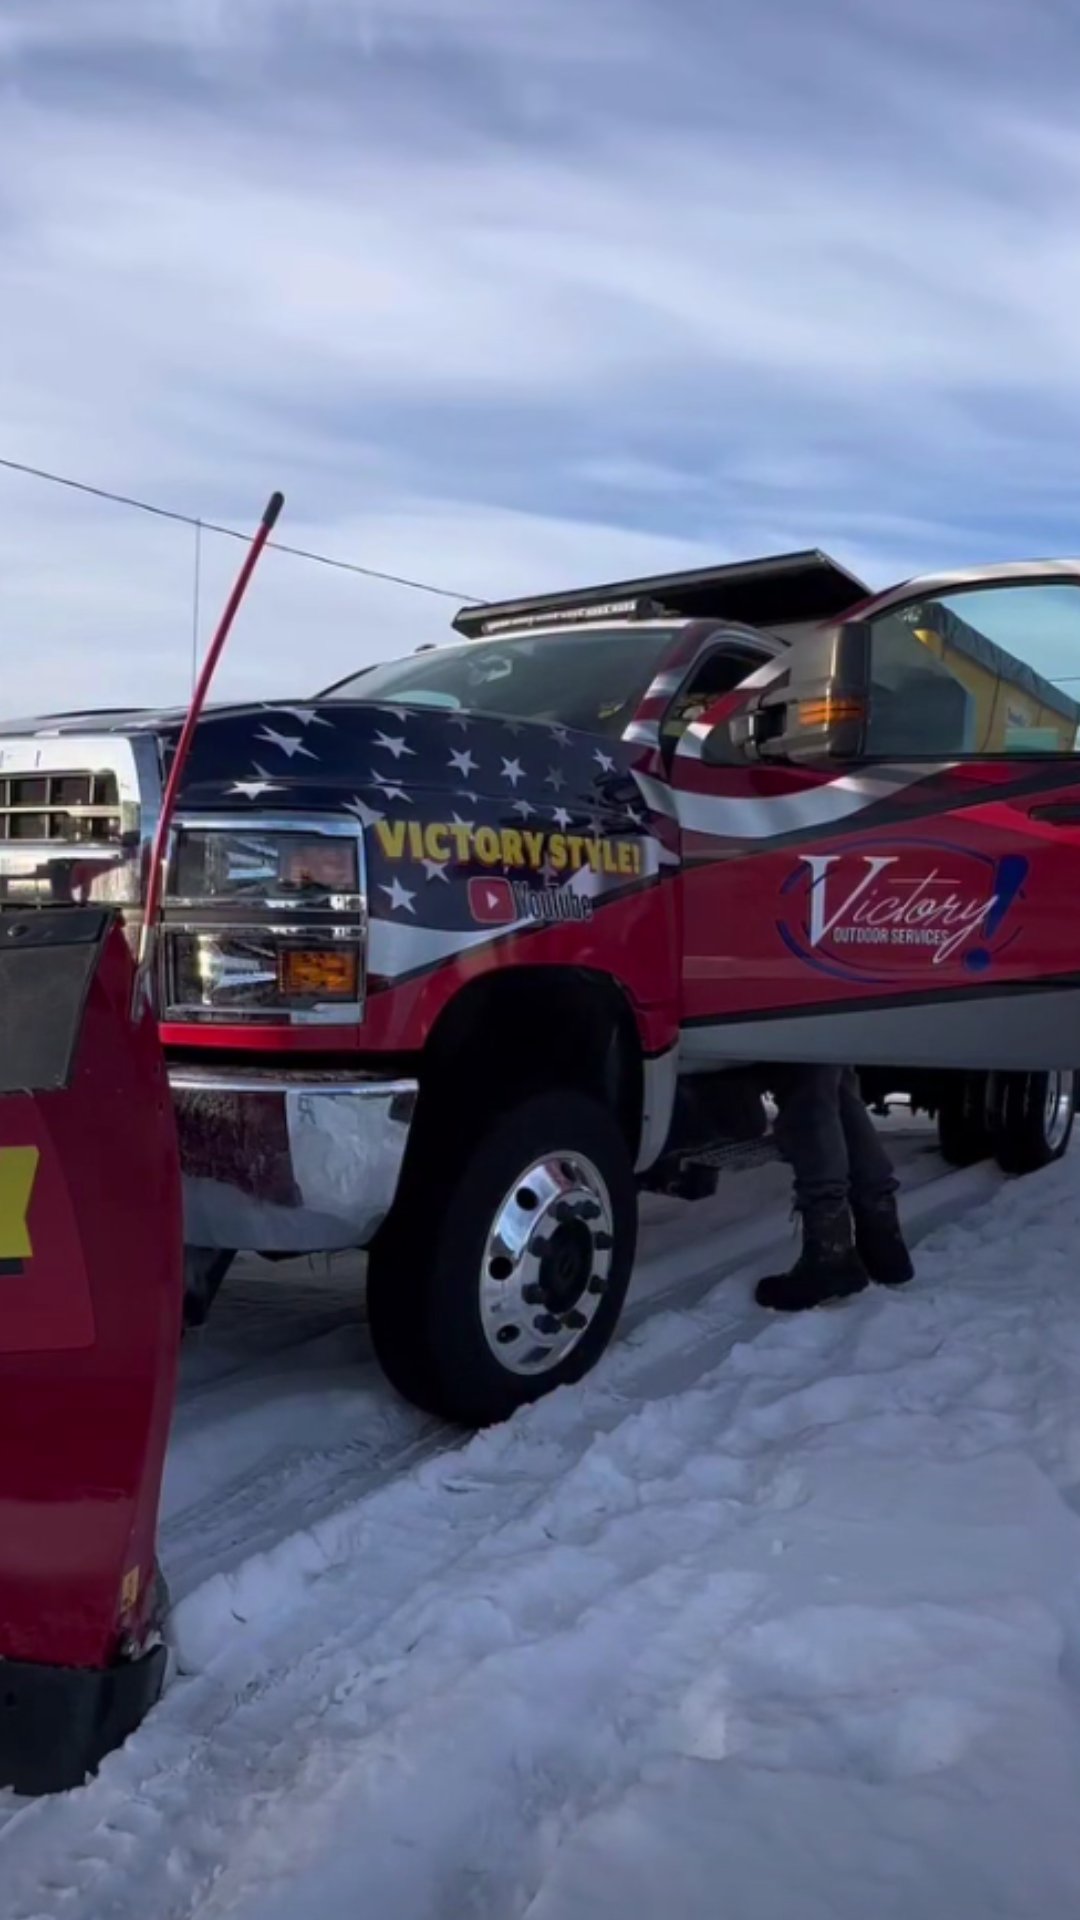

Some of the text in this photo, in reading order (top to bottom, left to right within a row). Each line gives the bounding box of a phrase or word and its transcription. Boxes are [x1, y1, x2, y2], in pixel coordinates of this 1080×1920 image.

[374, 819, 640, 873] VICTORY STYLE!
[514, 881, 593, 921] YouTube
[833, 926, 949, 945] OUTDOOR SERVICES
